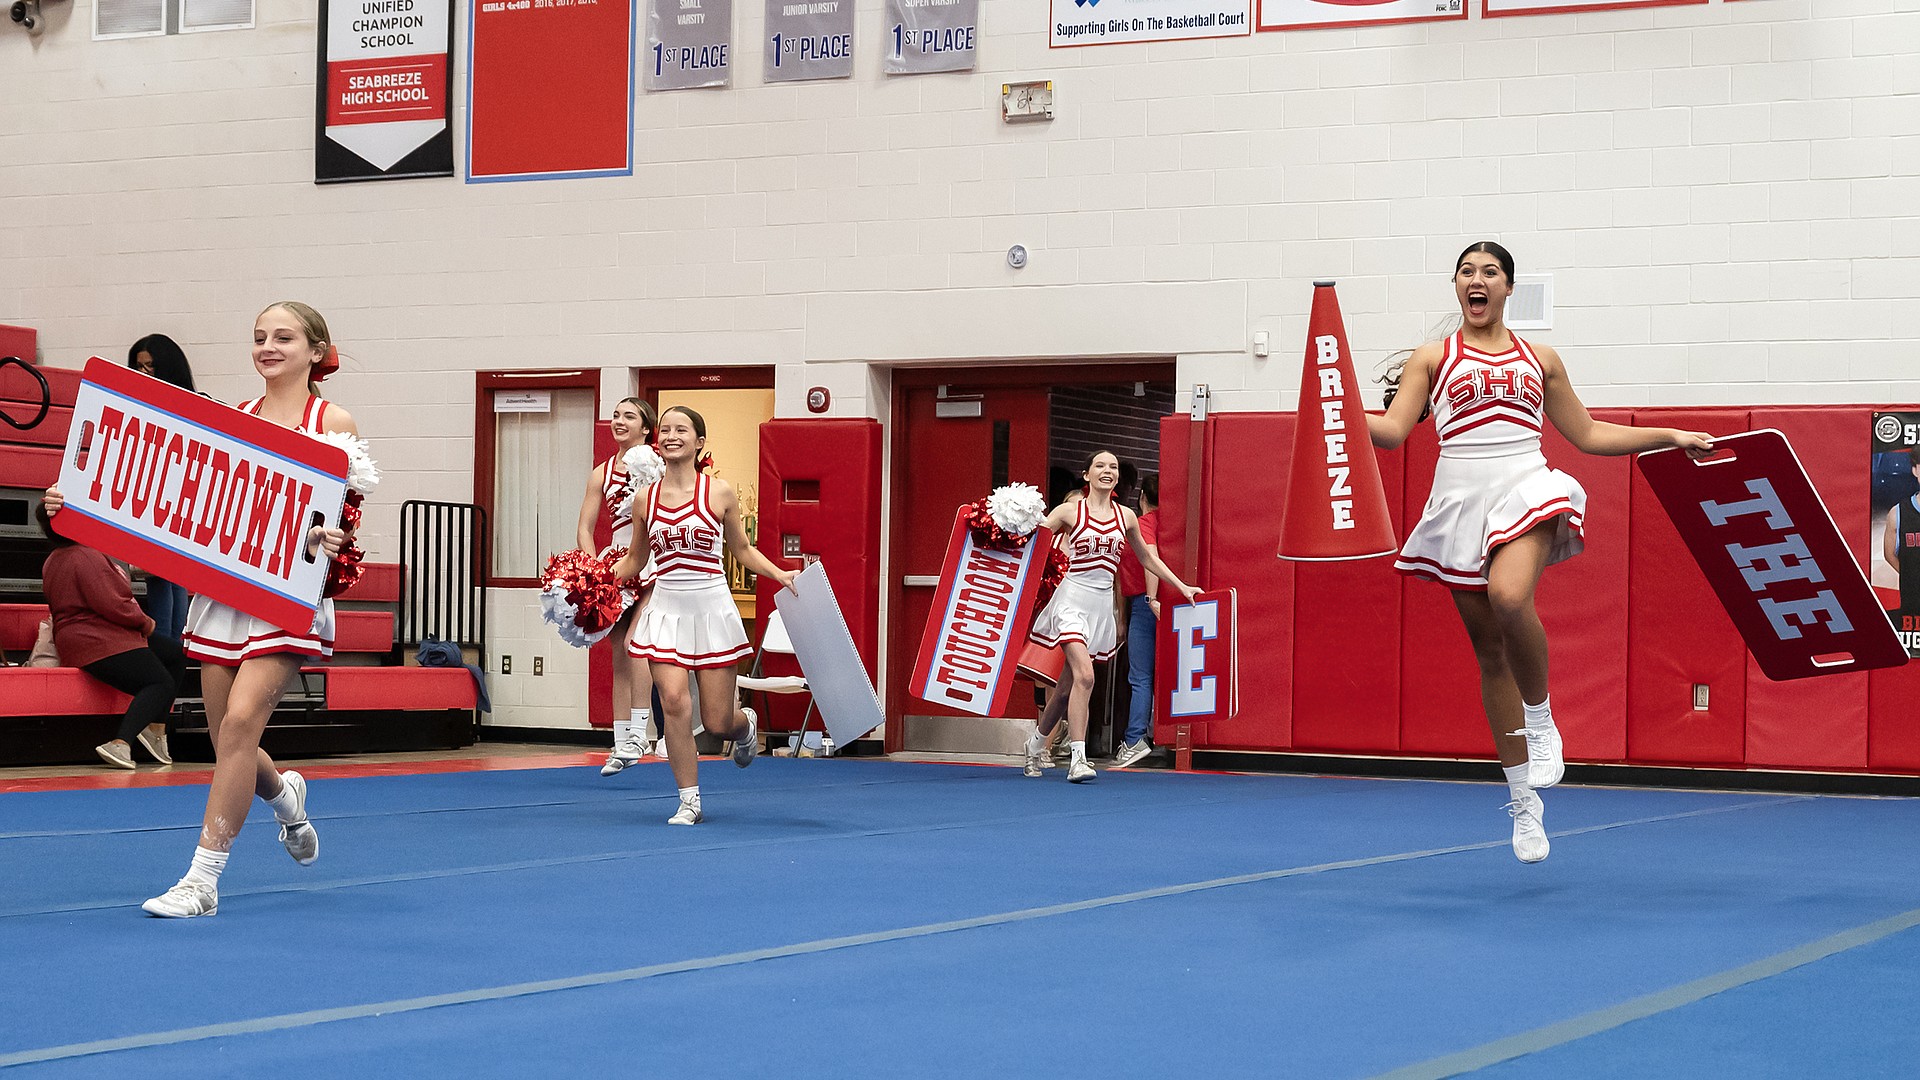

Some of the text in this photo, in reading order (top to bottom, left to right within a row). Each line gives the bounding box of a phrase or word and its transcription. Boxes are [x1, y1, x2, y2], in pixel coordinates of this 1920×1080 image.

[362, 0, 414, 14] UNIFIED
[482, 2, 505, 12] GIRLS
[506, 0, 531, 10] 4x400
[679, 0, 702, 9] SMALL
[782, 1, 839, 16] JUNIOR VARSITY
[352, 15, 424, 32] CHAMPION
[677, 13, 705, 25] VARSITY
[1056, 11, 1245, 38] Supporting Girls On The Basketball Court
[360, 33, 414, 49] SCHOOL
[800, 33, 851, 60] PLACE
[921, 26, 975, 53] PLACE
[680, 43, 728, 70] PLACE
[348, 72, 422, 90] SEABREEZE
[341, 87, 430, 105] HIGH SCHOOL
[1446, 367, 1545, 417] SHS
[1314, 334, 1355, 531] BREEZE
[87, 405, 314, 581] TOUCHDOWN
[1699, 477, 1855, 641] THE
[936, 549, 1023, 691] TOUCHDOW
[1170, 600, 1219, 718] E
